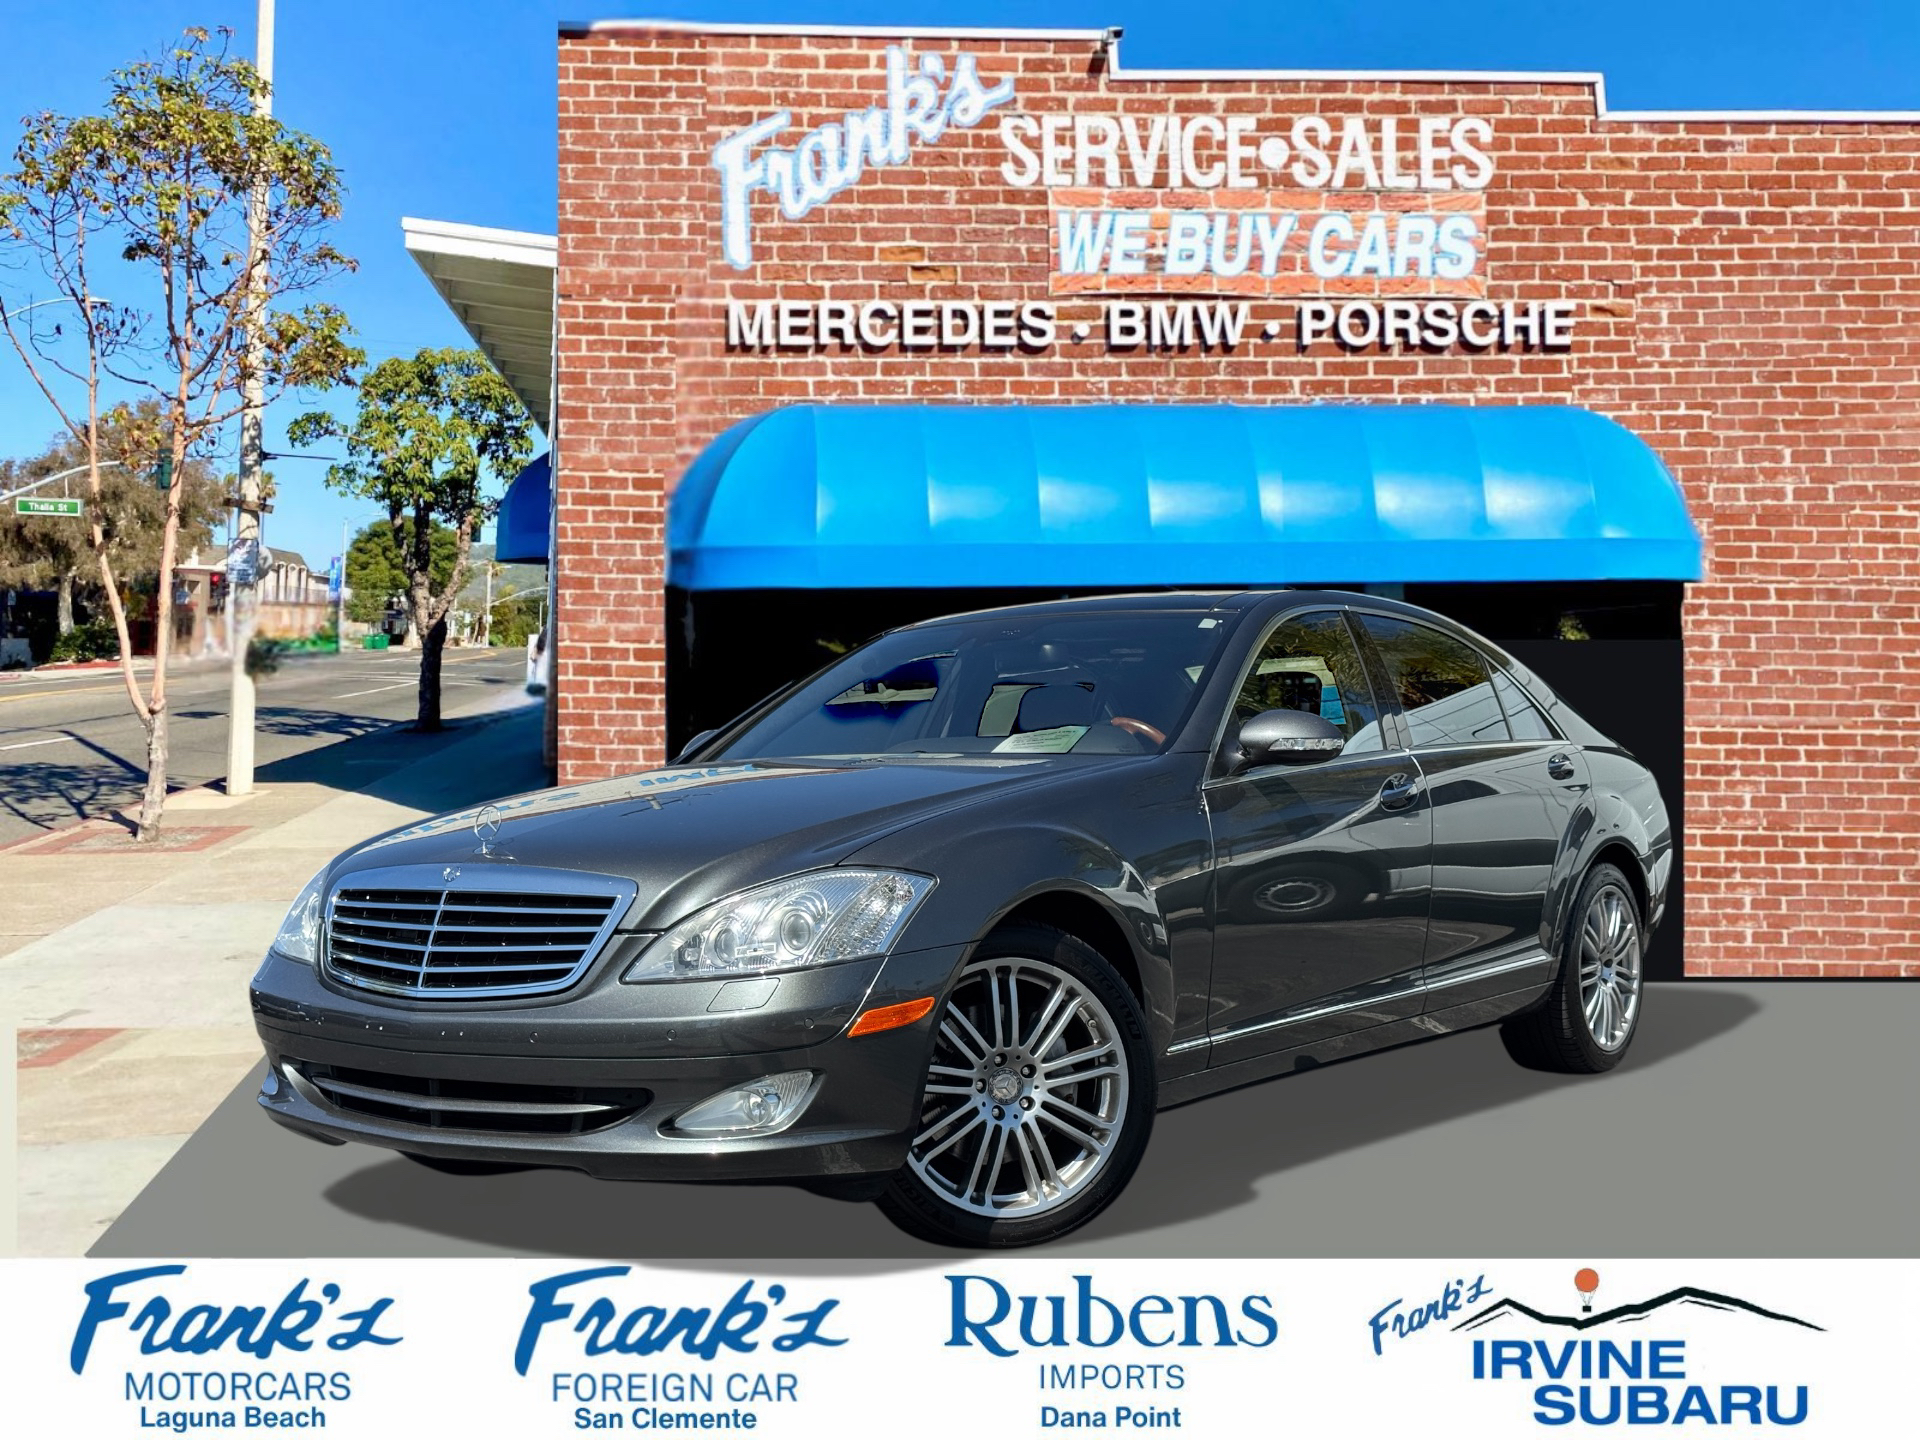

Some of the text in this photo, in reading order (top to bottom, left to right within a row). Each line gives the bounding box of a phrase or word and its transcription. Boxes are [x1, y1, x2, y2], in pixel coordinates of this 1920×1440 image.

[712, 44, 1016, 270] Frank's
[999, 115, 1495, 190] SERVICE SALES
[1057, 209, 1480, 280] WE BUY CARS
[727, 299, 1578, 351] MERCEDES BMW PORSCHE
[57, 503, 68, 512] St
